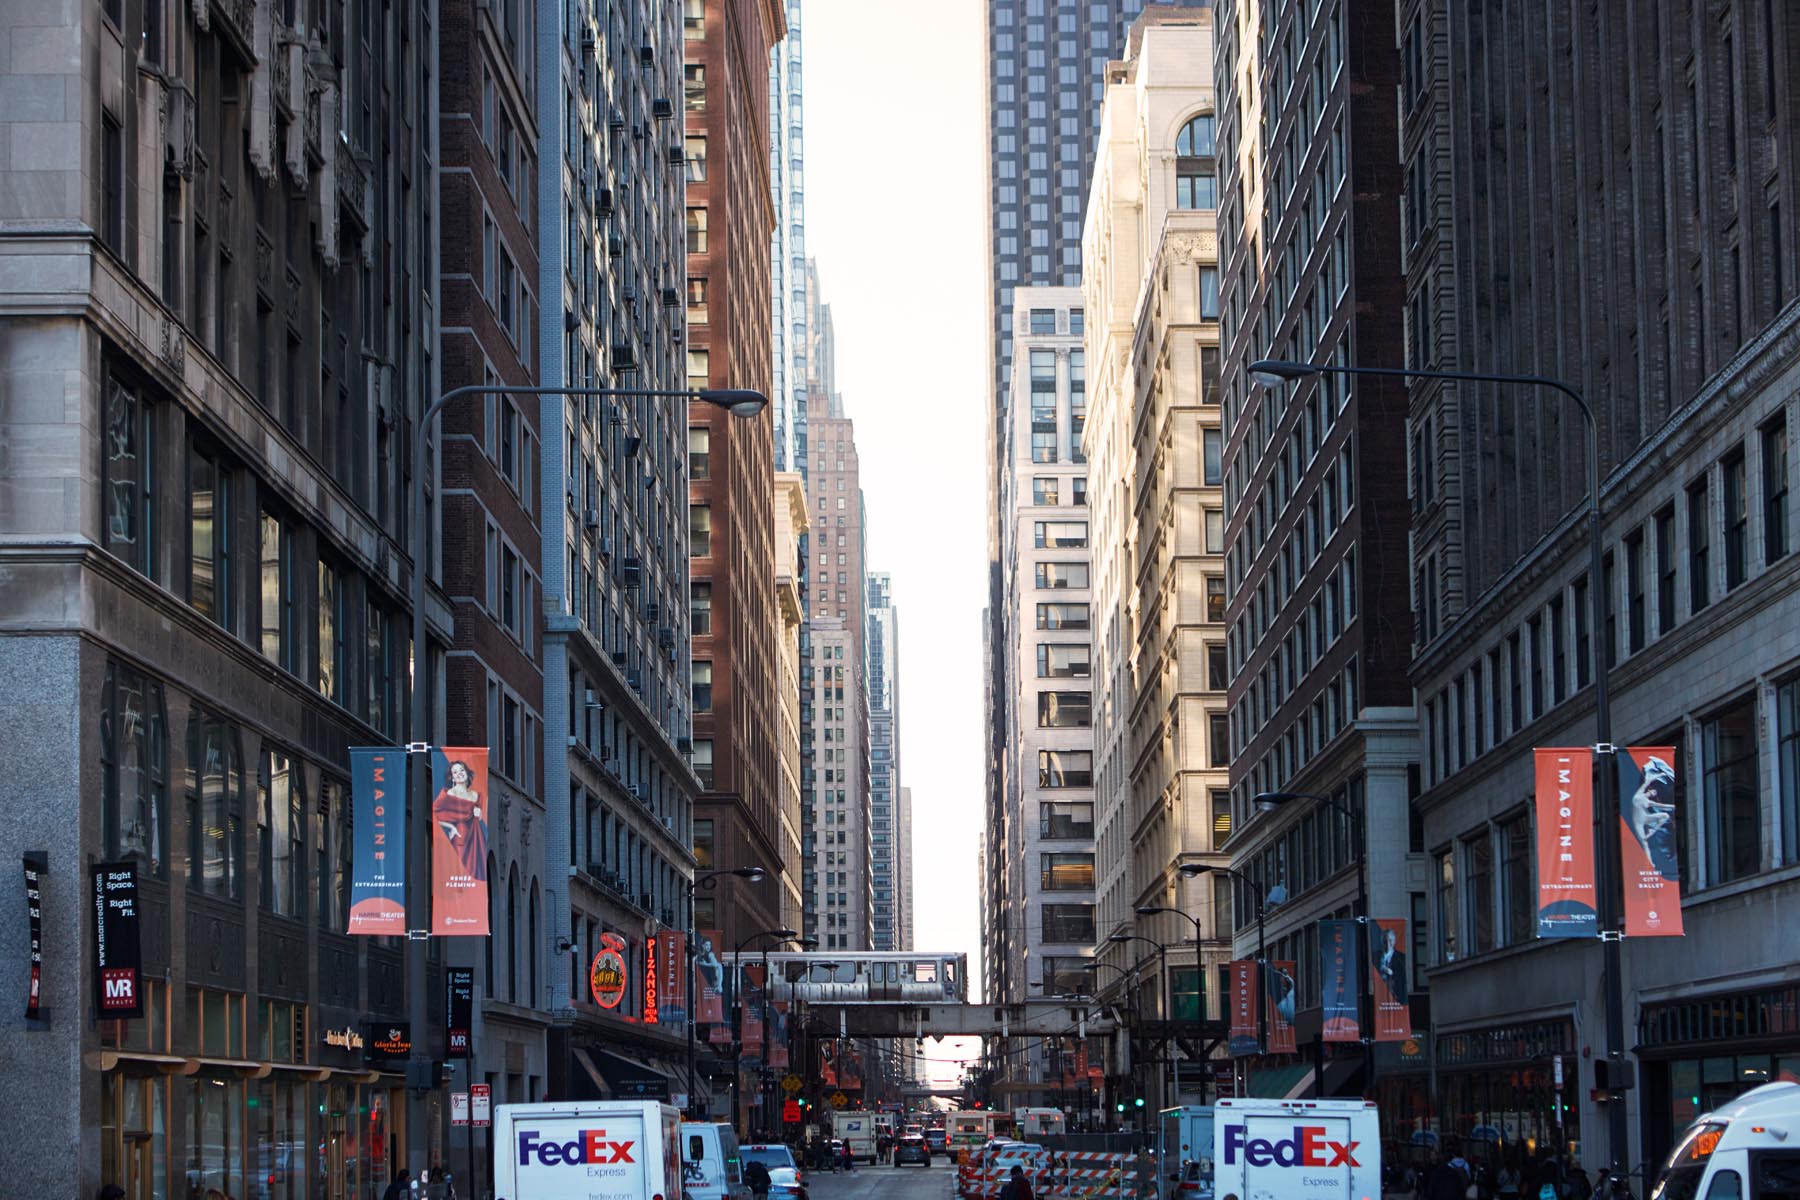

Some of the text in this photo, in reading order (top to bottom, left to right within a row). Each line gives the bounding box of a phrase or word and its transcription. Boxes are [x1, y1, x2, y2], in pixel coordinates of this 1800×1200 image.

[374, 757, 384, 860] IMAGINE
[1558, 757, 1572, 862] IMAGINE
[108, 872, 131, 882] Right
[106, 881, 134, 890] Space.
[110, 900, 132, 909] Right
[122, 909, 136, 917] Fit.
[96, 873, 104, 966] www.marcrealty.com
[106, 979, 133, 998] MR
[451, 1035, 466, 1046] MR
[519, 1130, 635, 1166] FedEx
[1224, 1124, 1361, 1168] FedEx
[587, 1167, 626, 1177] Express
[1303, 1176, 1339, 1187] Express
[589, 1192, 632, 1200] fedex.com
